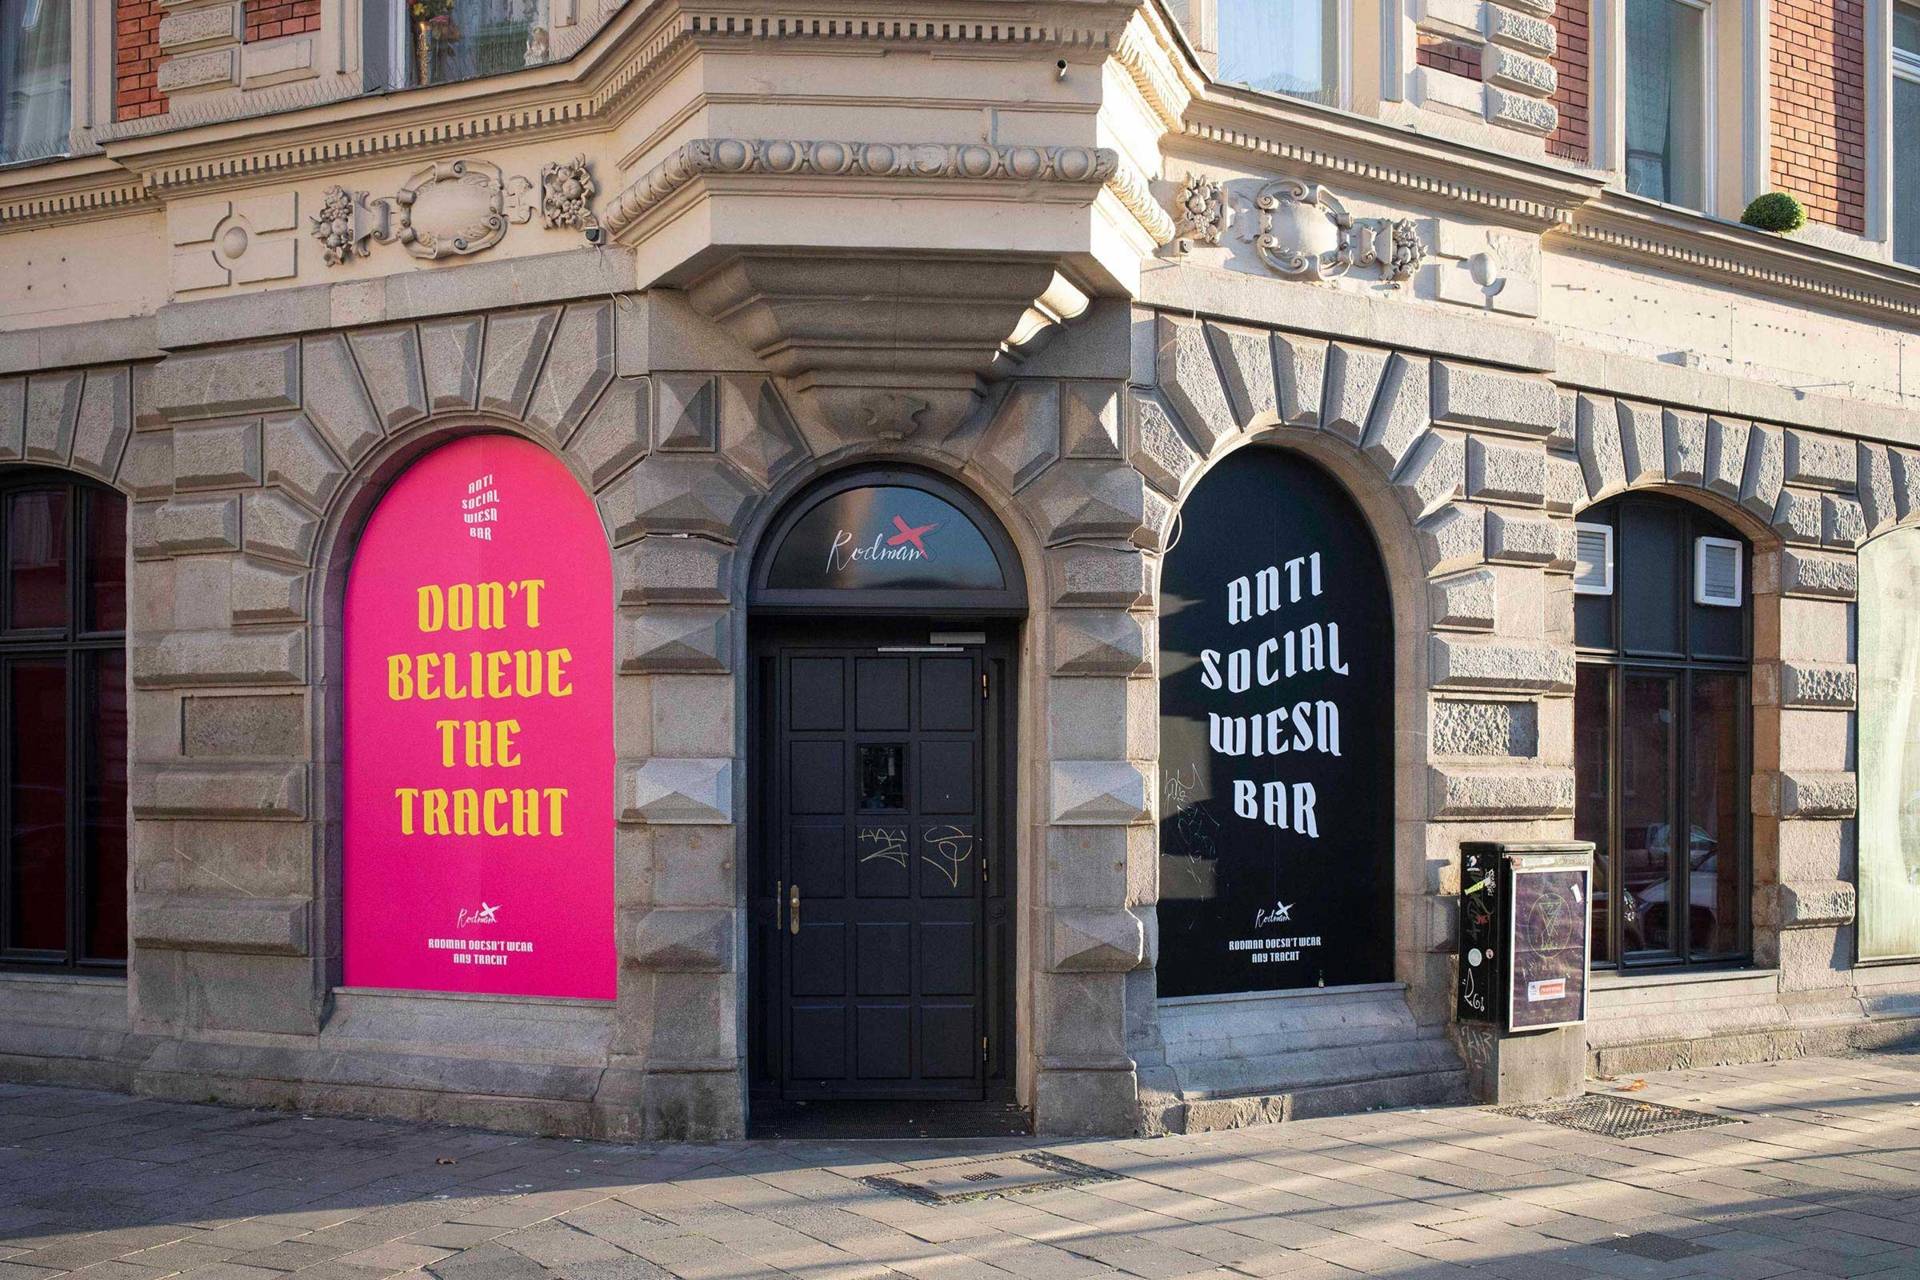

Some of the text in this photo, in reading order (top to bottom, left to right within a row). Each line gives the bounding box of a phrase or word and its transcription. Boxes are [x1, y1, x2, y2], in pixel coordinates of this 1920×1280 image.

[461, 489, 500, 510] SOCIAL
[468, 474, 493, 494] ANTI
[463, 507, 498, 524] WIESN
[469, 527, 492, 541] BAR
[826, 529, 927, 575] Rodman
[417, 580, 545, 632] DON'T
[1226, 551, 1324, 627] ANTI
[387, 647, 573, 701] BELIEVE
[1200, 622, 1349, 694] SOCIAL
[436, 719, 521, 768] THE
[1208, 700, 1342, 757] WIESN
[395, 788, 569, 837] TRACHT
[1233, 779, 1320, 839] BAR
[428, 938, 533, 952] RODMAN DOESN'T WEAR
[453, 953, 508, 965] ANY TRACHT
[1229, 936, 1321, 950] RODMAN DOESN'T WEAR
[1251, 951, 1300, 963] ANY TRACHT
